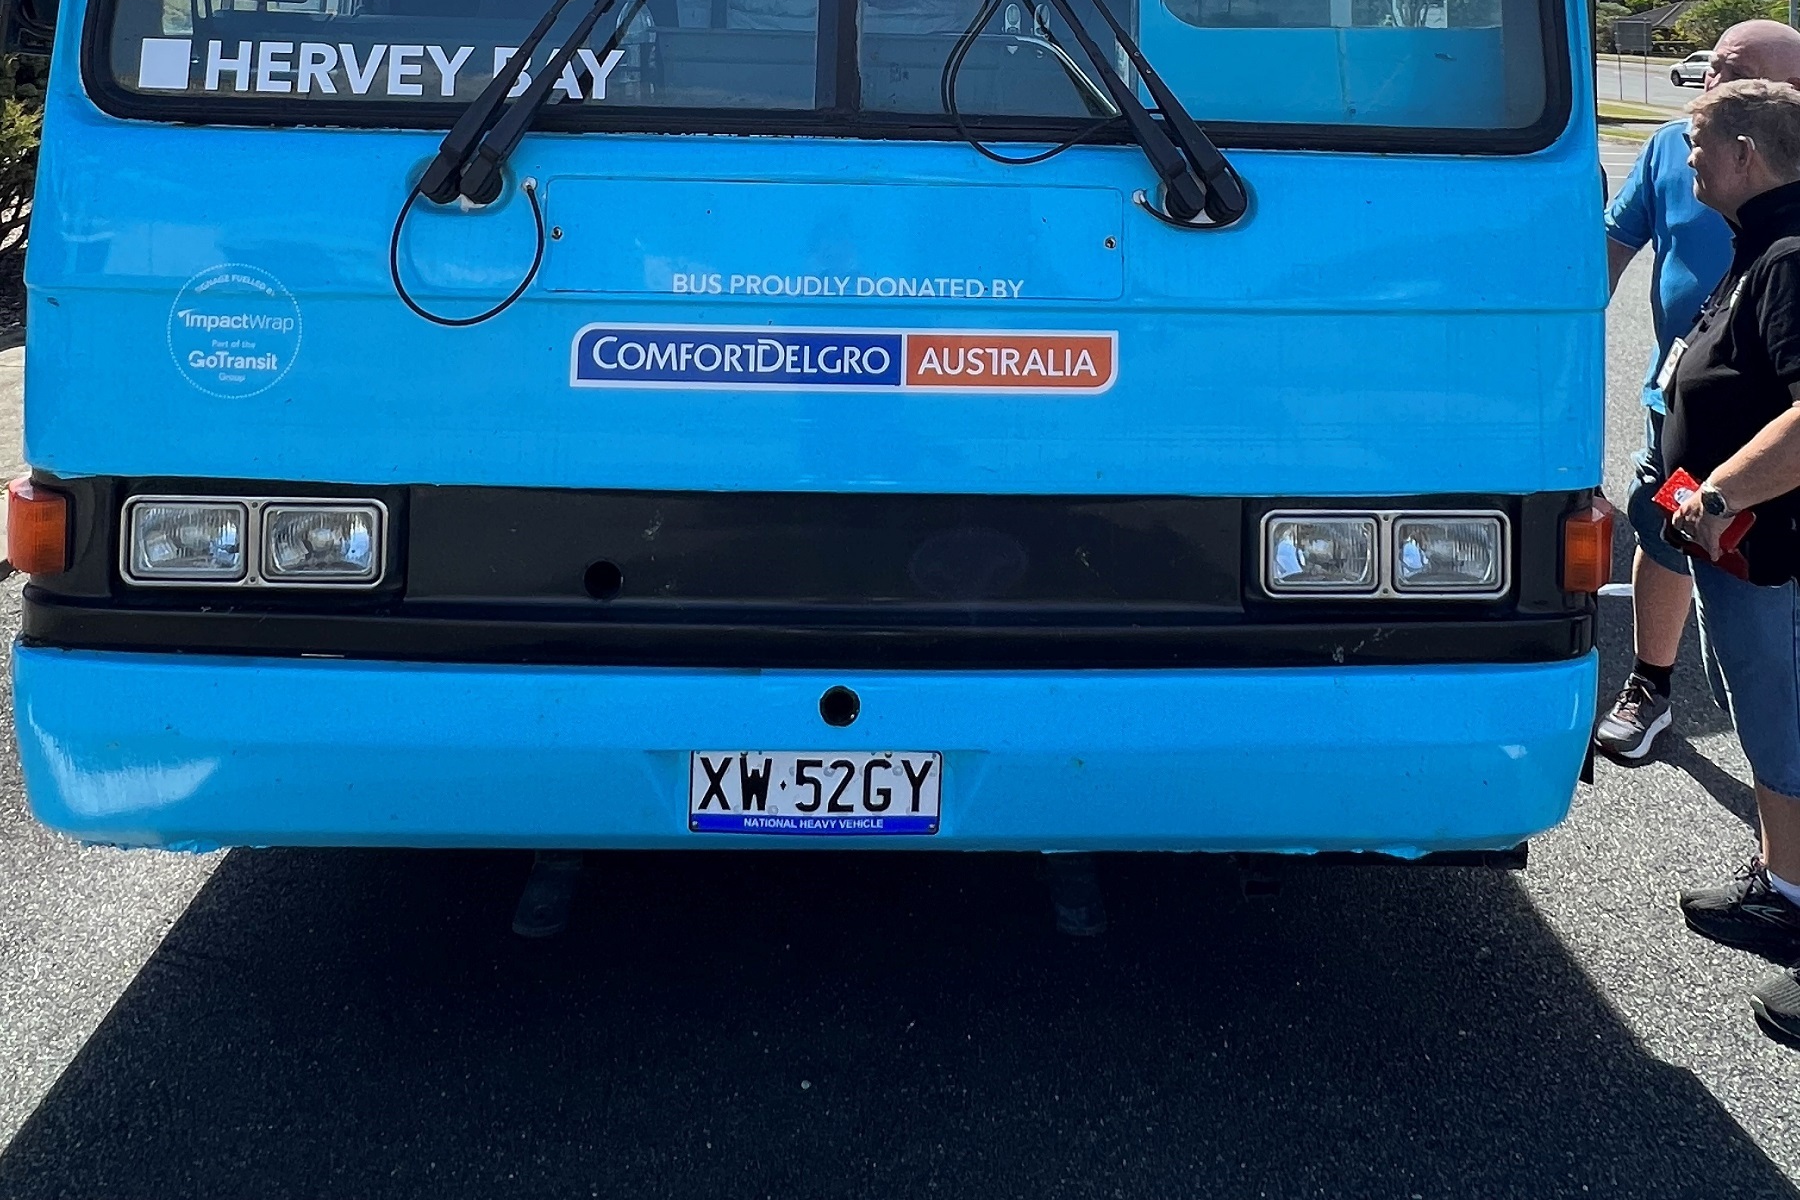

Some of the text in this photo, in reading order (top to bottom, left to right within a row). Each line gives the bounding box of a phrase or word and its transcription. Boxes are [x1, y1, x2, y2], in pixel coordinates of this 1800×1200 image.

[204, 39, 626, 100] HERVEY BAY
[672, 273, 1025, 300] BUS PROUDLY DONATED BY
[178, 308, 295, 334] ImpactWrap
[211, 339, 256, 349] Part of the
[188, 350, 278, 371] GoTransit
[917, 346, 1098, 377] AUSTRALIA
[218, 372, 246, 383] Group
[698, 756, 934, 814] XW 52GY
[744, 817, 884, 830] NATIONAL HEAVY VEHICLE
